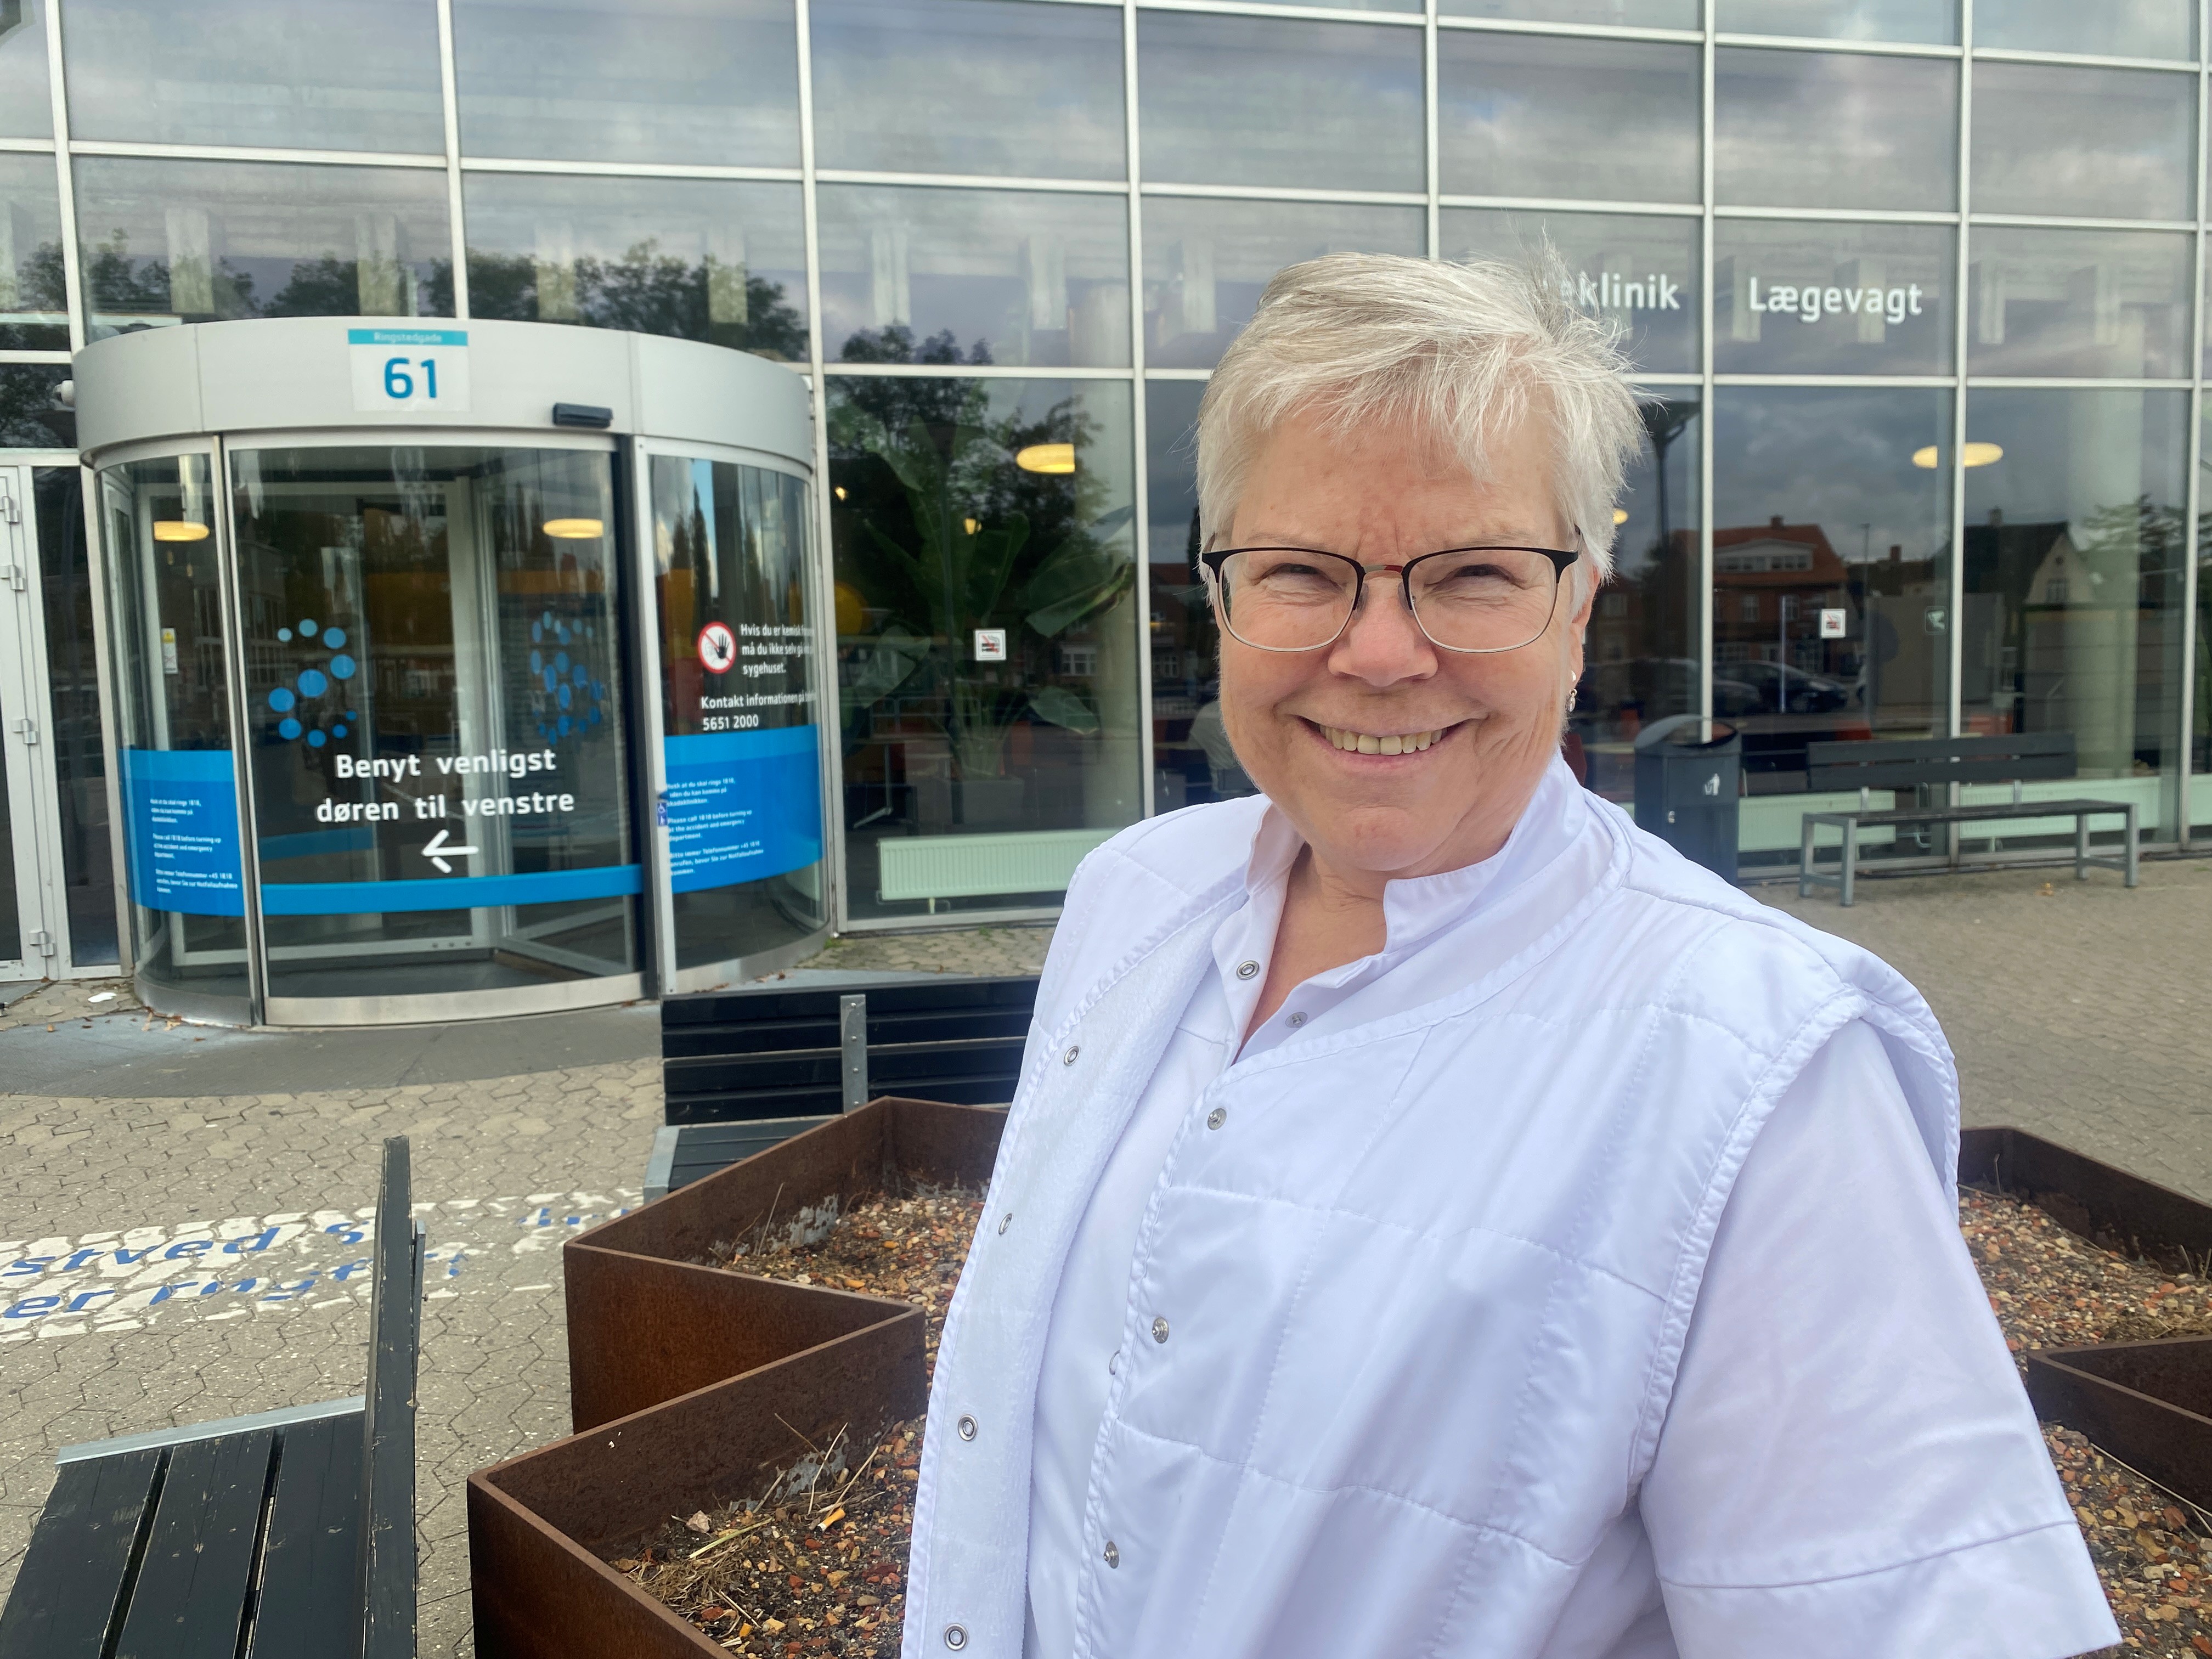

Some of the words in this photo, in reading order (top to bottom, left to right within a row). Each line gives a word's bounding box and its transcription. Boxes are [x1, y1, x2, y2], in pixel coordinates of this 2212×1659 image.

[1750, 276, 1923, 324] Lægevagt
[384, 357, 437, 399] 61
[741, 623, 760, 636] Hvis
[762, 623, 772, 636] du
[774, 627, 781, 636] er
[742, 642, 755, 655] må
[757, 642, 768, 655] du
[769, 642, 783, 654] ikke
[785, 642, 796, 654] selv
[743, 662, 786, 678] sygehuset.
[701, 694, 744, 709] Kontakt
[747, 691, 798, 706] informationen
[703, 716, 729, 731] 5651
[733, 714, 759, 729] 2000
[336, 754, 421, 783] Benyt
[437, 749, 556, 778] venligst
[317, 798, 399, 823] døren
[415, 794, 446, 819] til
[462, 792, 574, 817] venstre
